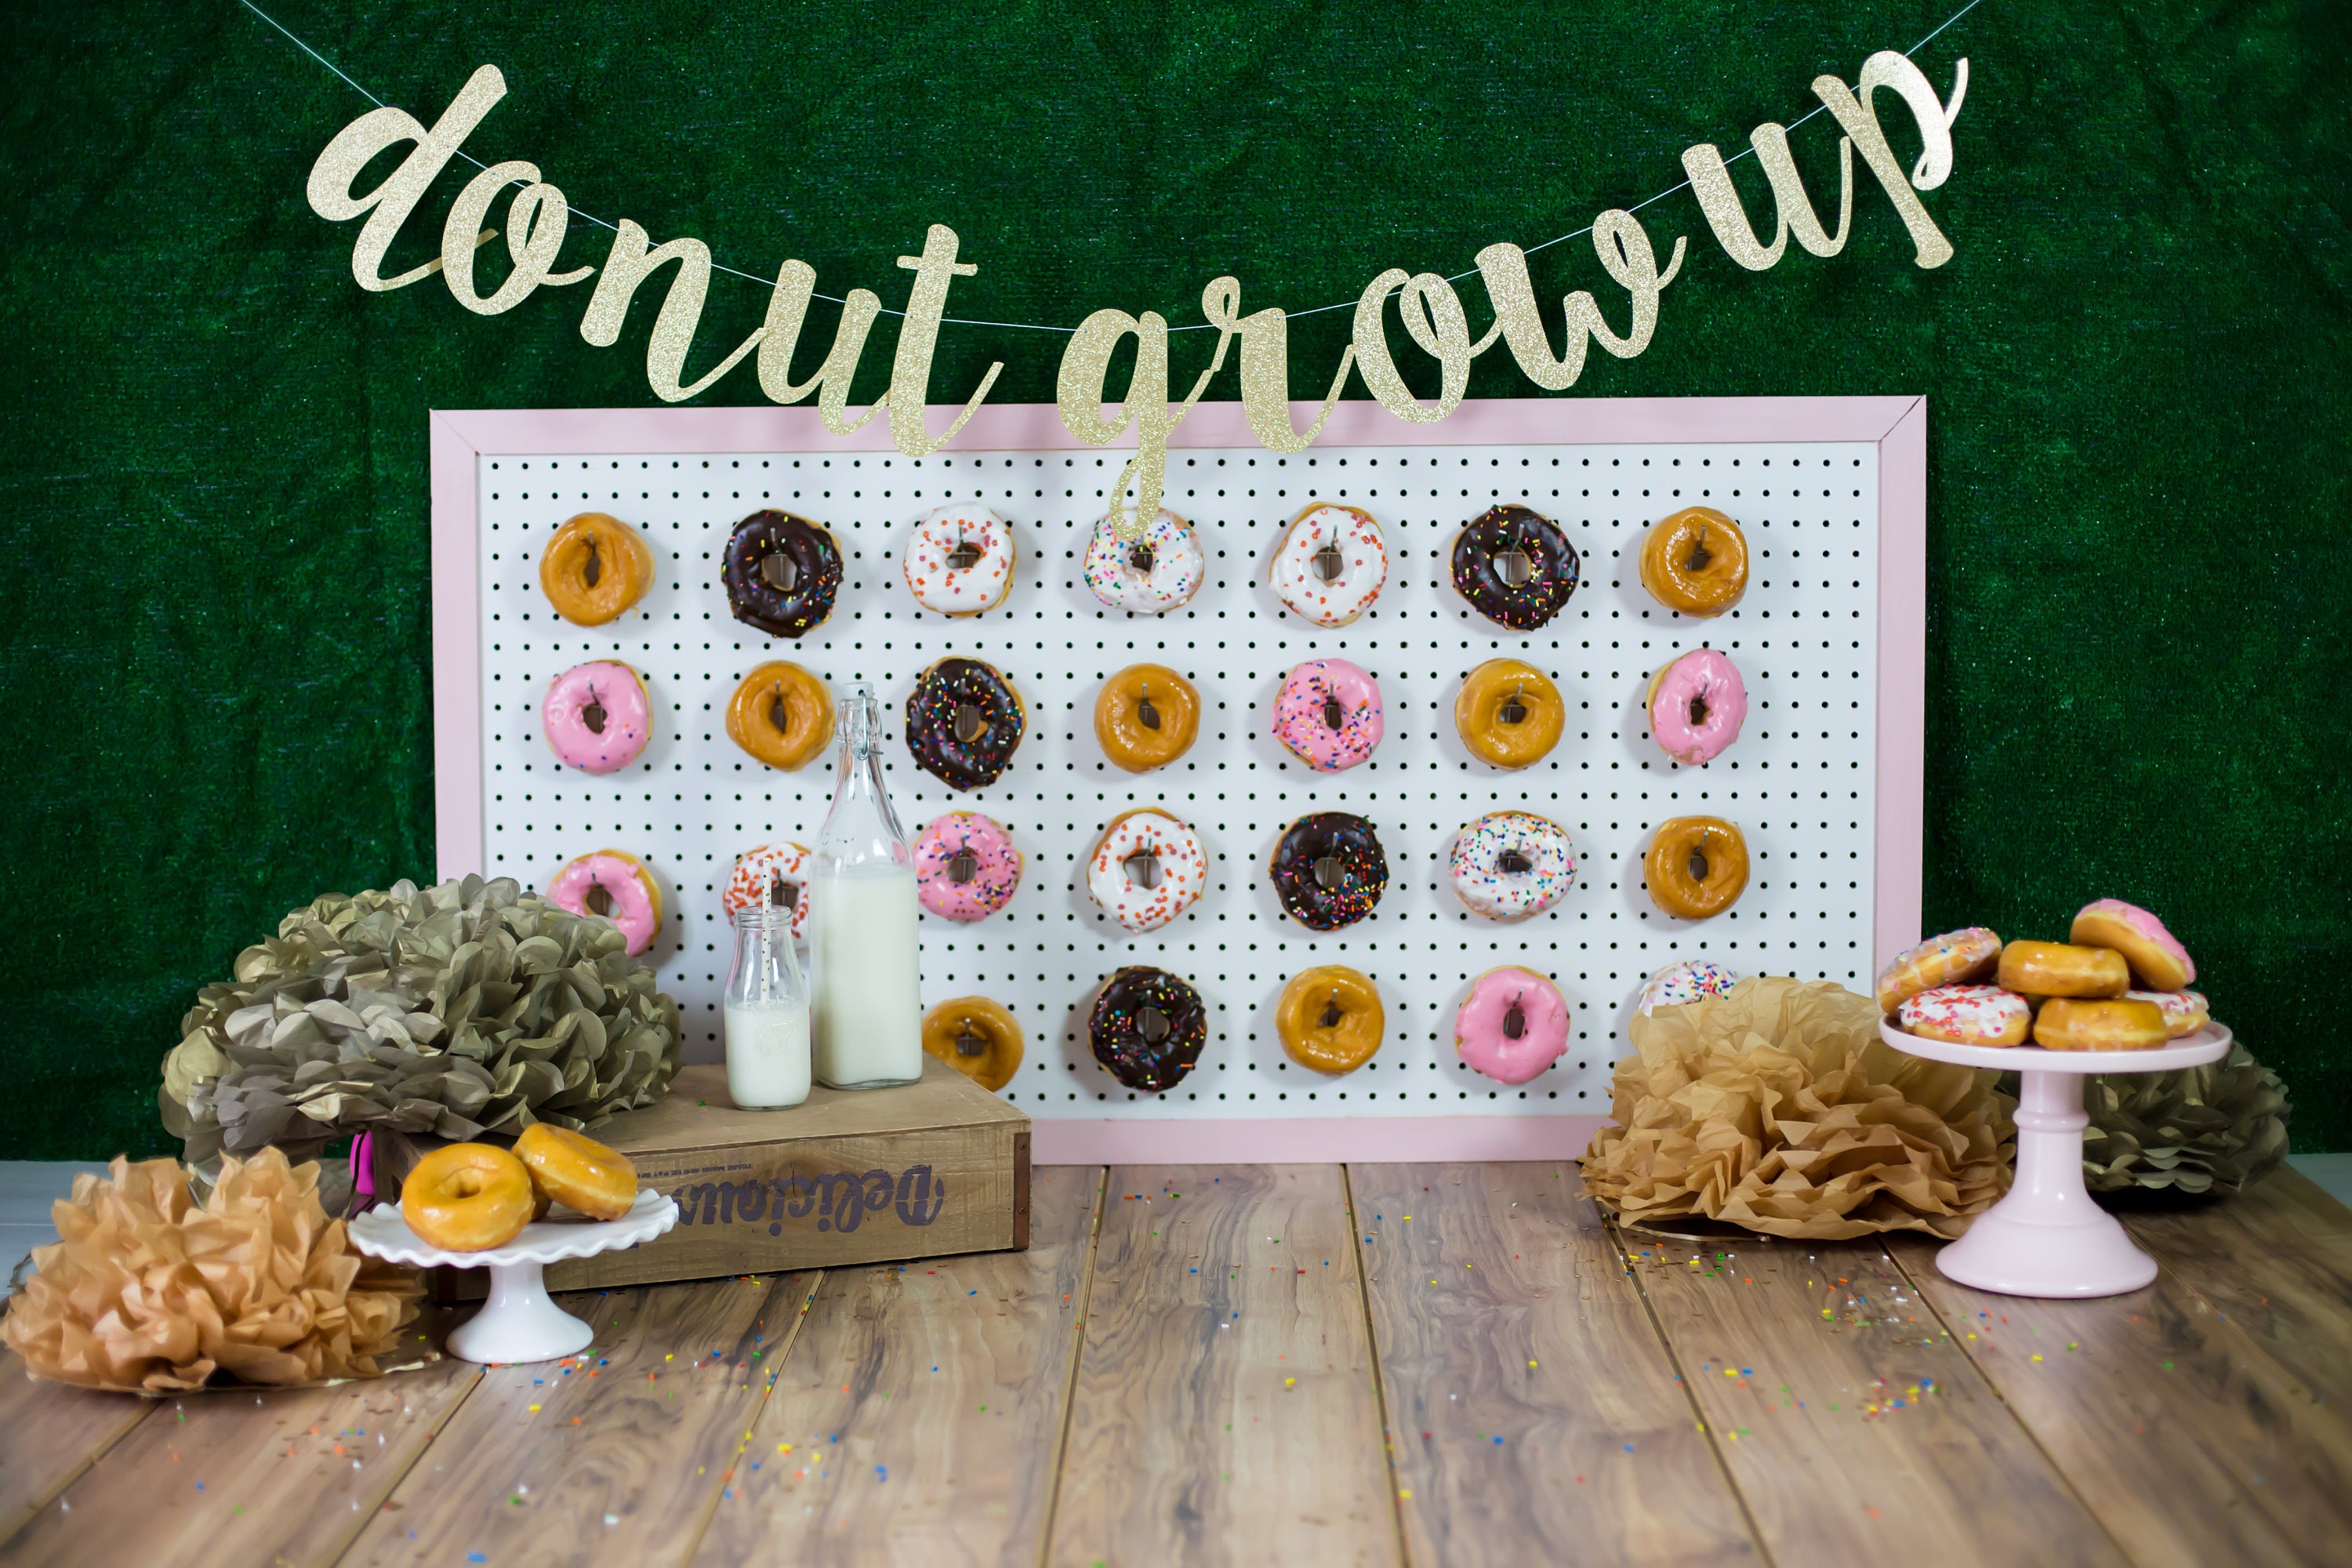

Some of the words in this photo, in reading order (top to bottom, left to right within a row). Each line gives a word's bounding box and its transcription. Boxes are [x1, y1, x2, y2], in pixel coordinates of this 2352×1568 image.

[307, 64, 1004, 457] donut
[1056, 209, 1687, 539] grow
[1682, 49, 1969, 269] up
[671, 1163, 946, 1236] Delicious
